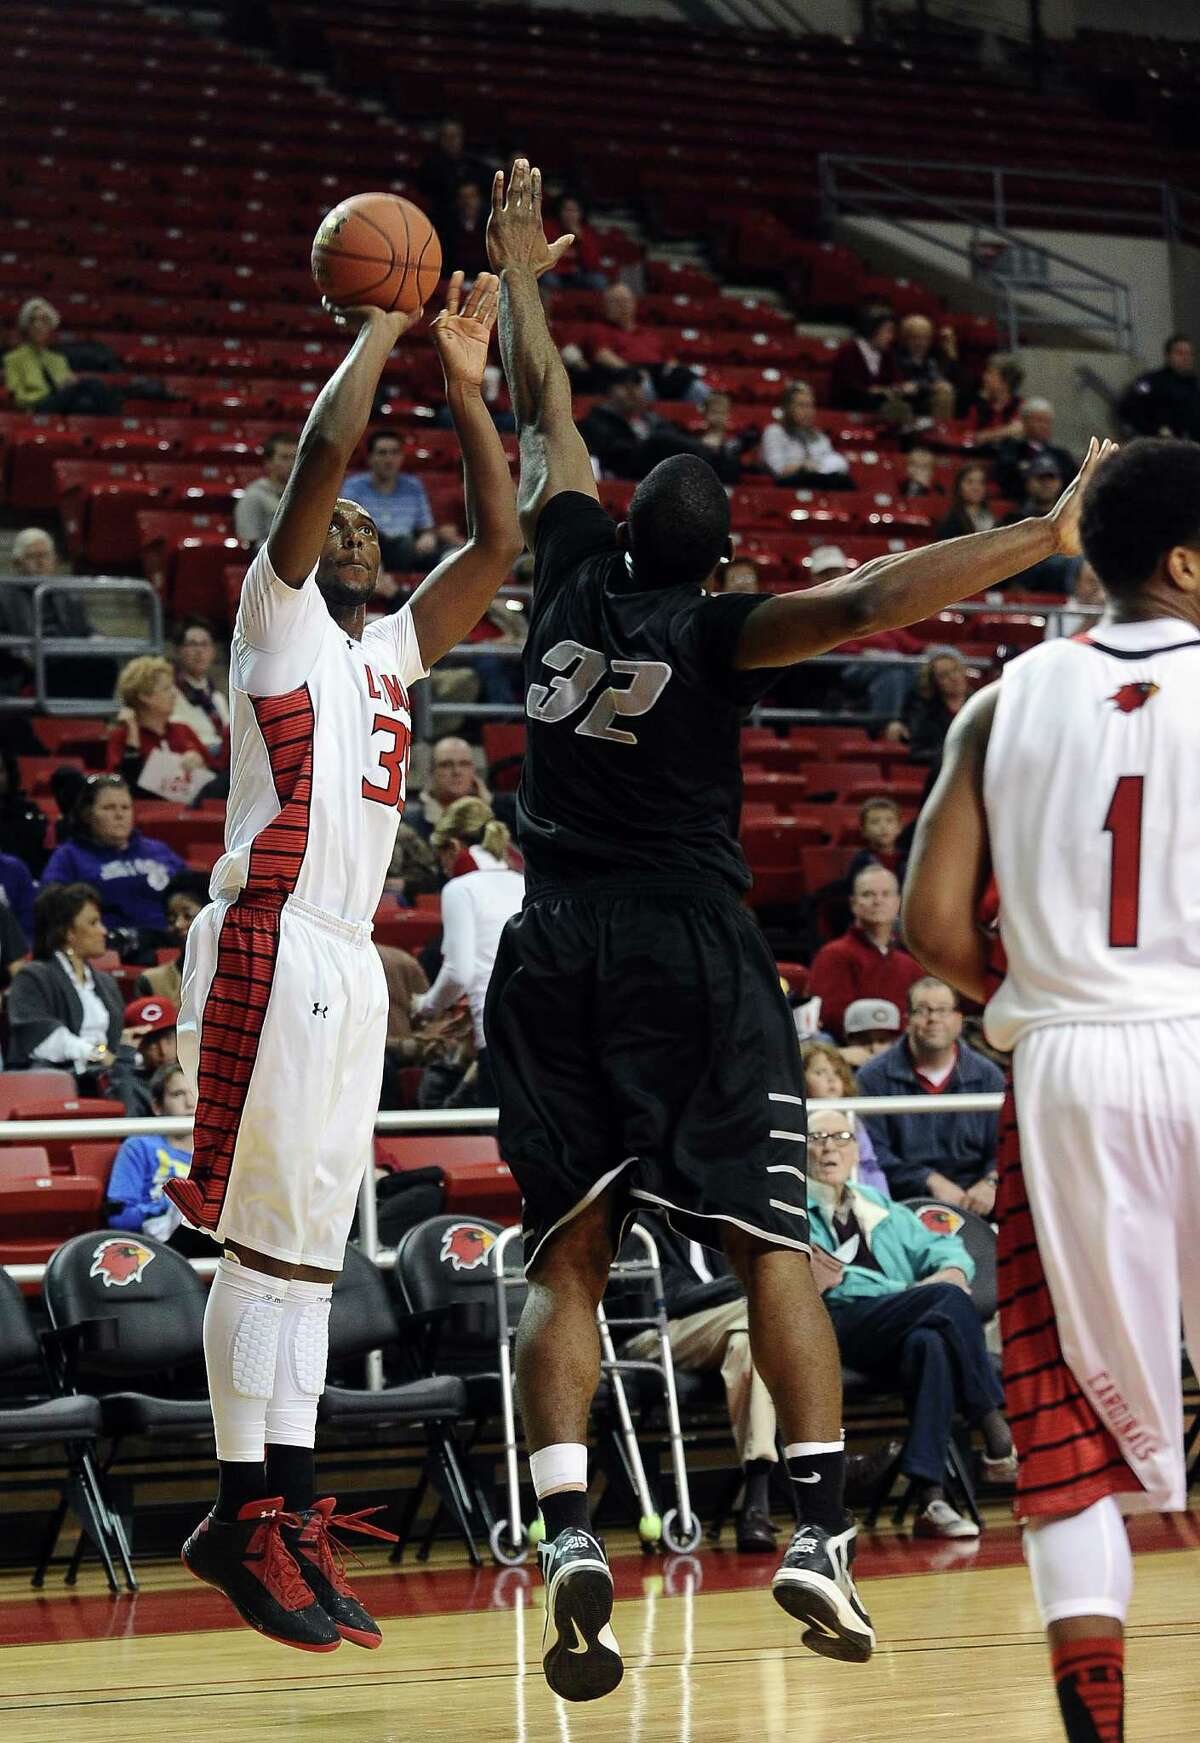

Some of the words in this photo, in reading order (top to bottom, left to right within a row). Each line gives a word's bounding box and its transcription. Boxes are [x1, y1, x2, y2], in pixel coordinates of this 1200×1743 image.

[526, 639, 673, 745] 32
[361, 713, 413, 815] 3
[1102, 775, 1145, 948] 1
